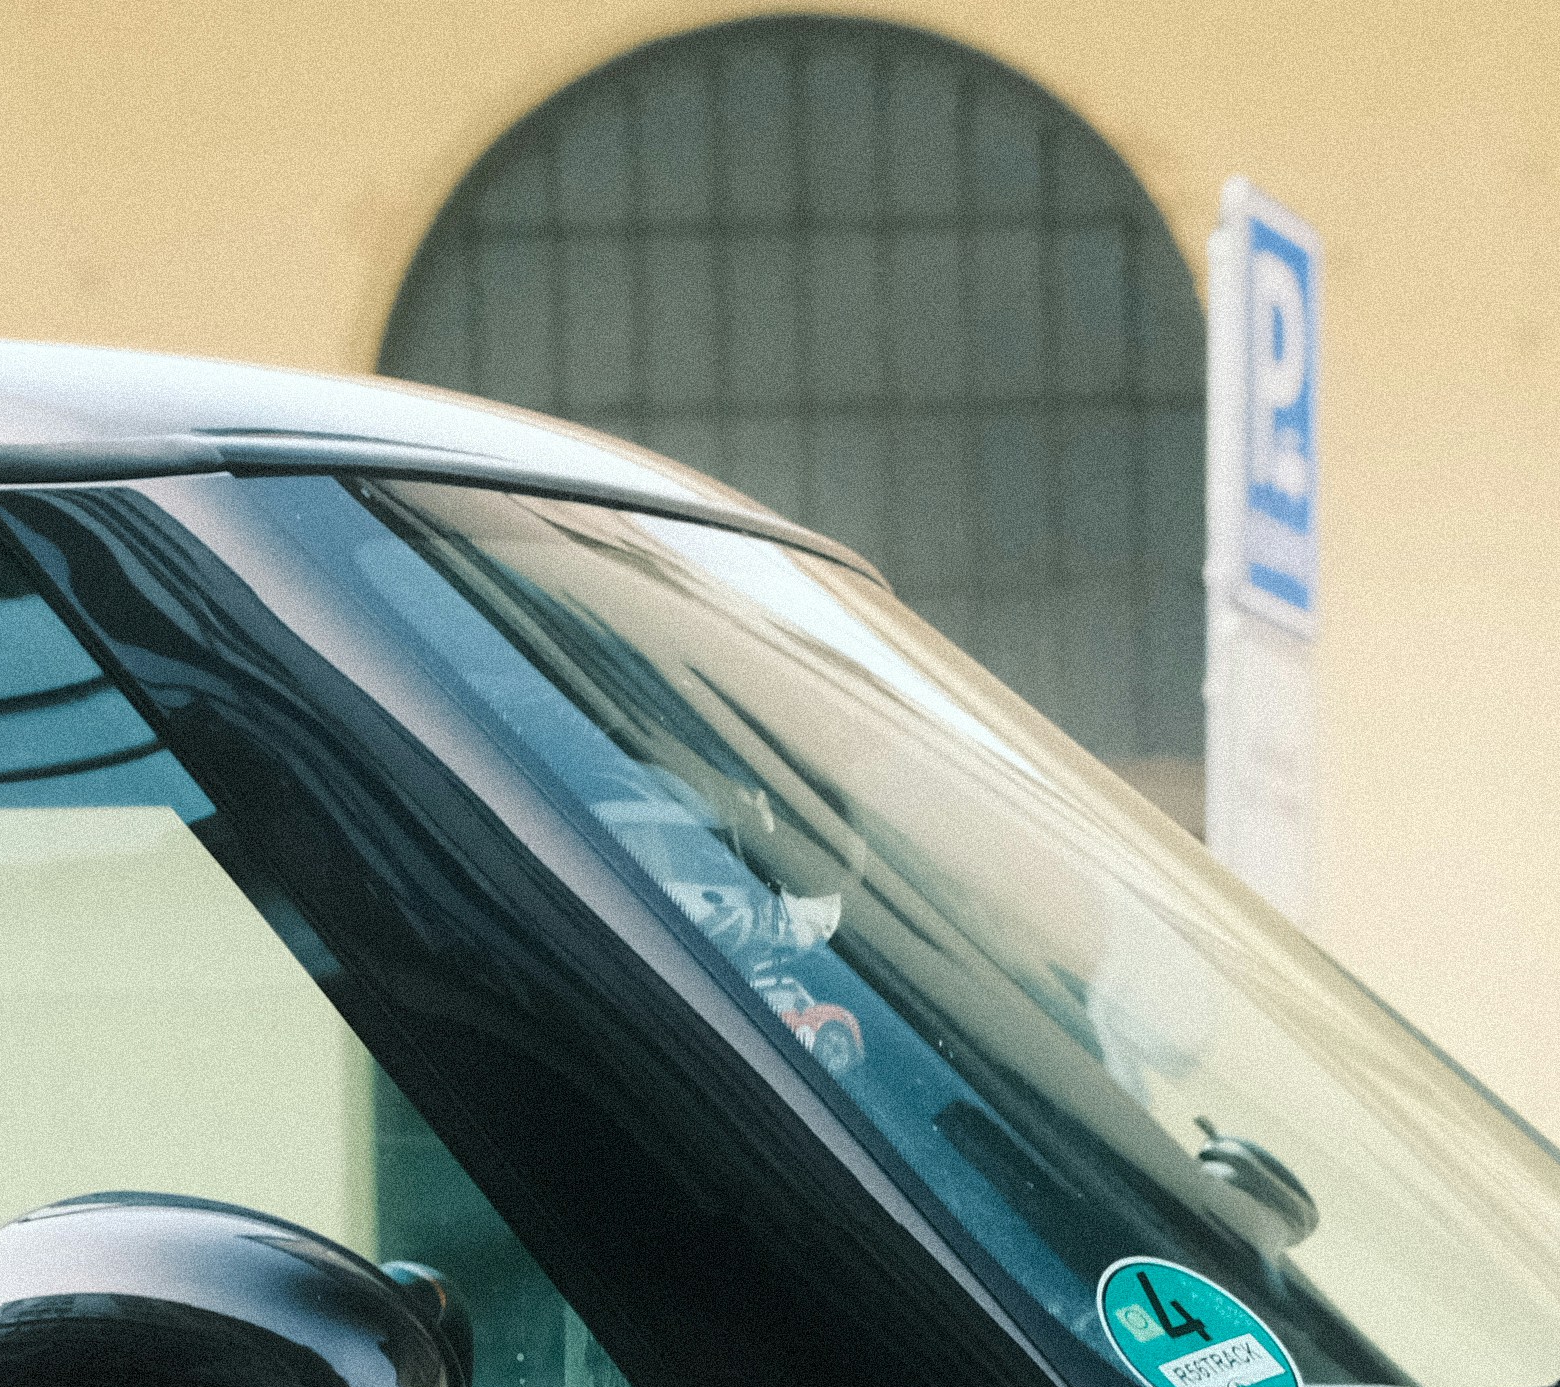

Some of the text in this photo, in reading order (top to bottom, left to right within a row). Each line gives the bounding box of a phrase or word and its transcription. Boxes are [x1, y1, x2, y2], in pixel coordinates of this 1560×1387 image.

[1253, 245, 1307, 490] P
[1136, 1271, 1212, 1342] 4
[1172, 1341, 1263, 1387] R56TRACK
